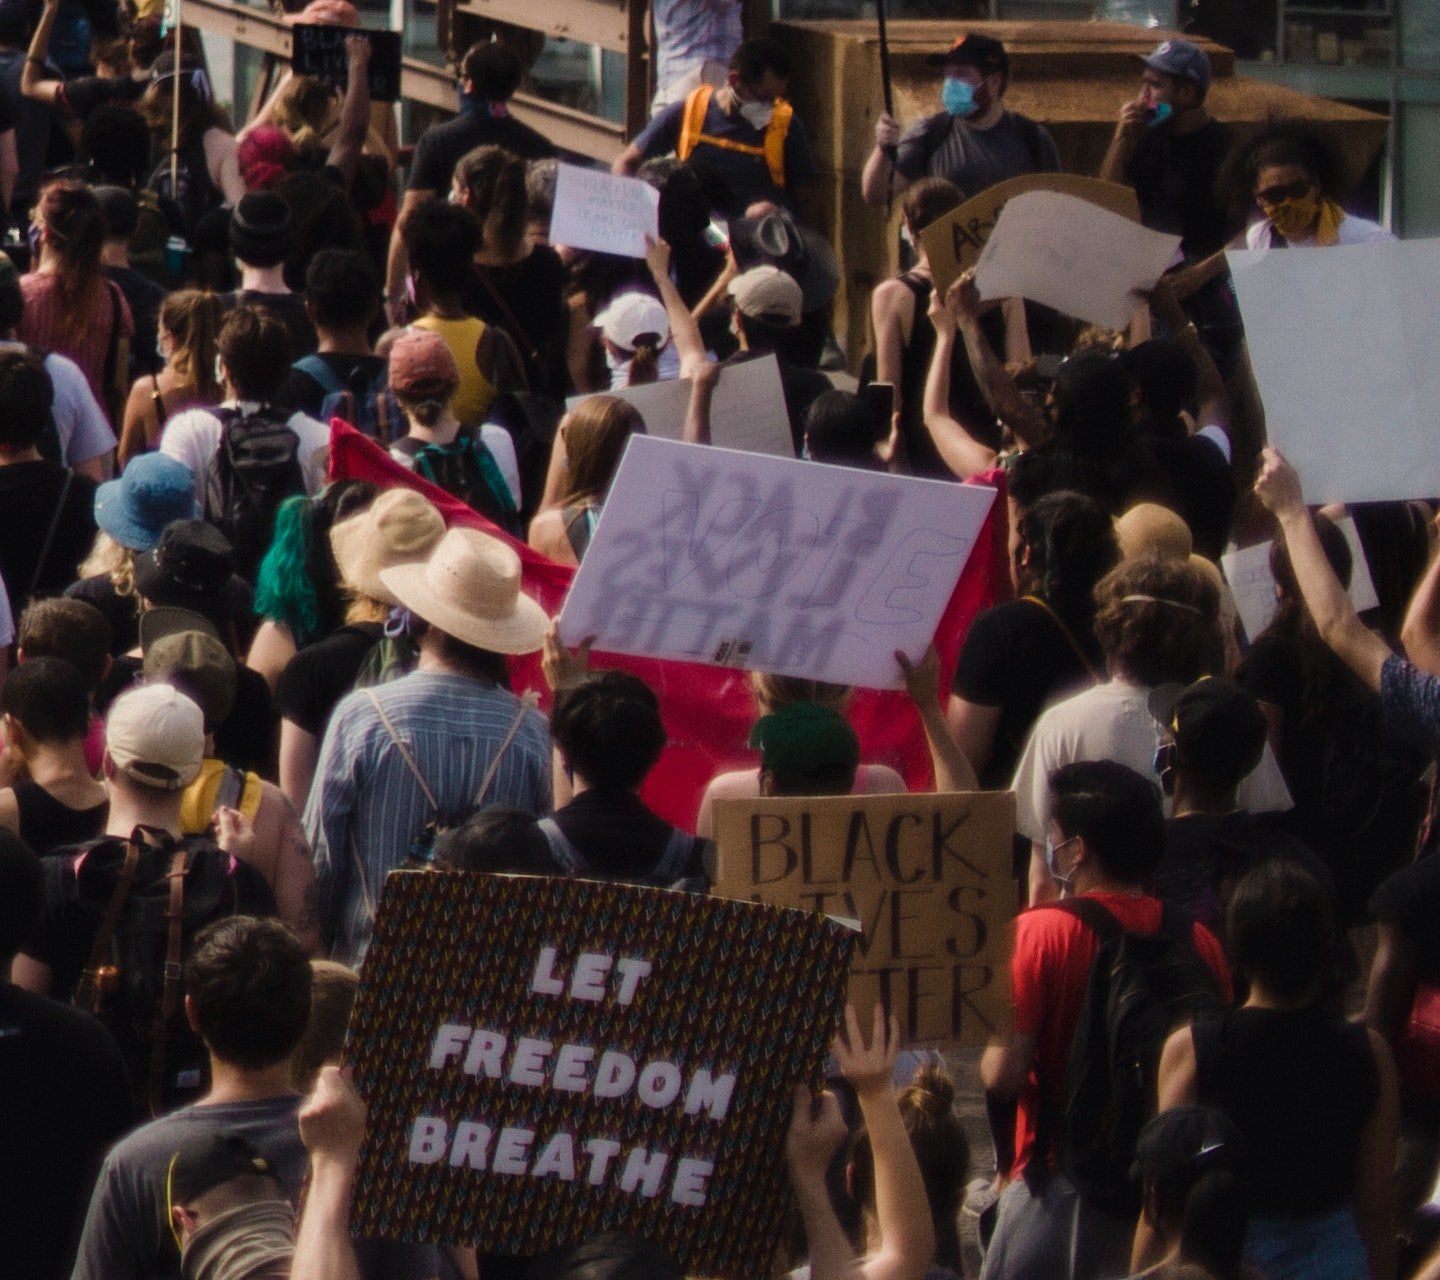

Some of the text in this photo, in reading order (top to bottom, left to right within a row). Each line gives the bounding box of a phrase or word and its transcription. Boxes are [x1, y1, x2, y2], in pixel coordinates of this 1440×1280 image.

[750, 811, 989, 886] BLACK
[531, 946, 652, 1006] LET
[430, 1023, 737, 1121] FREEDOM
[408, 1115, 714, 1207] BREATHE
